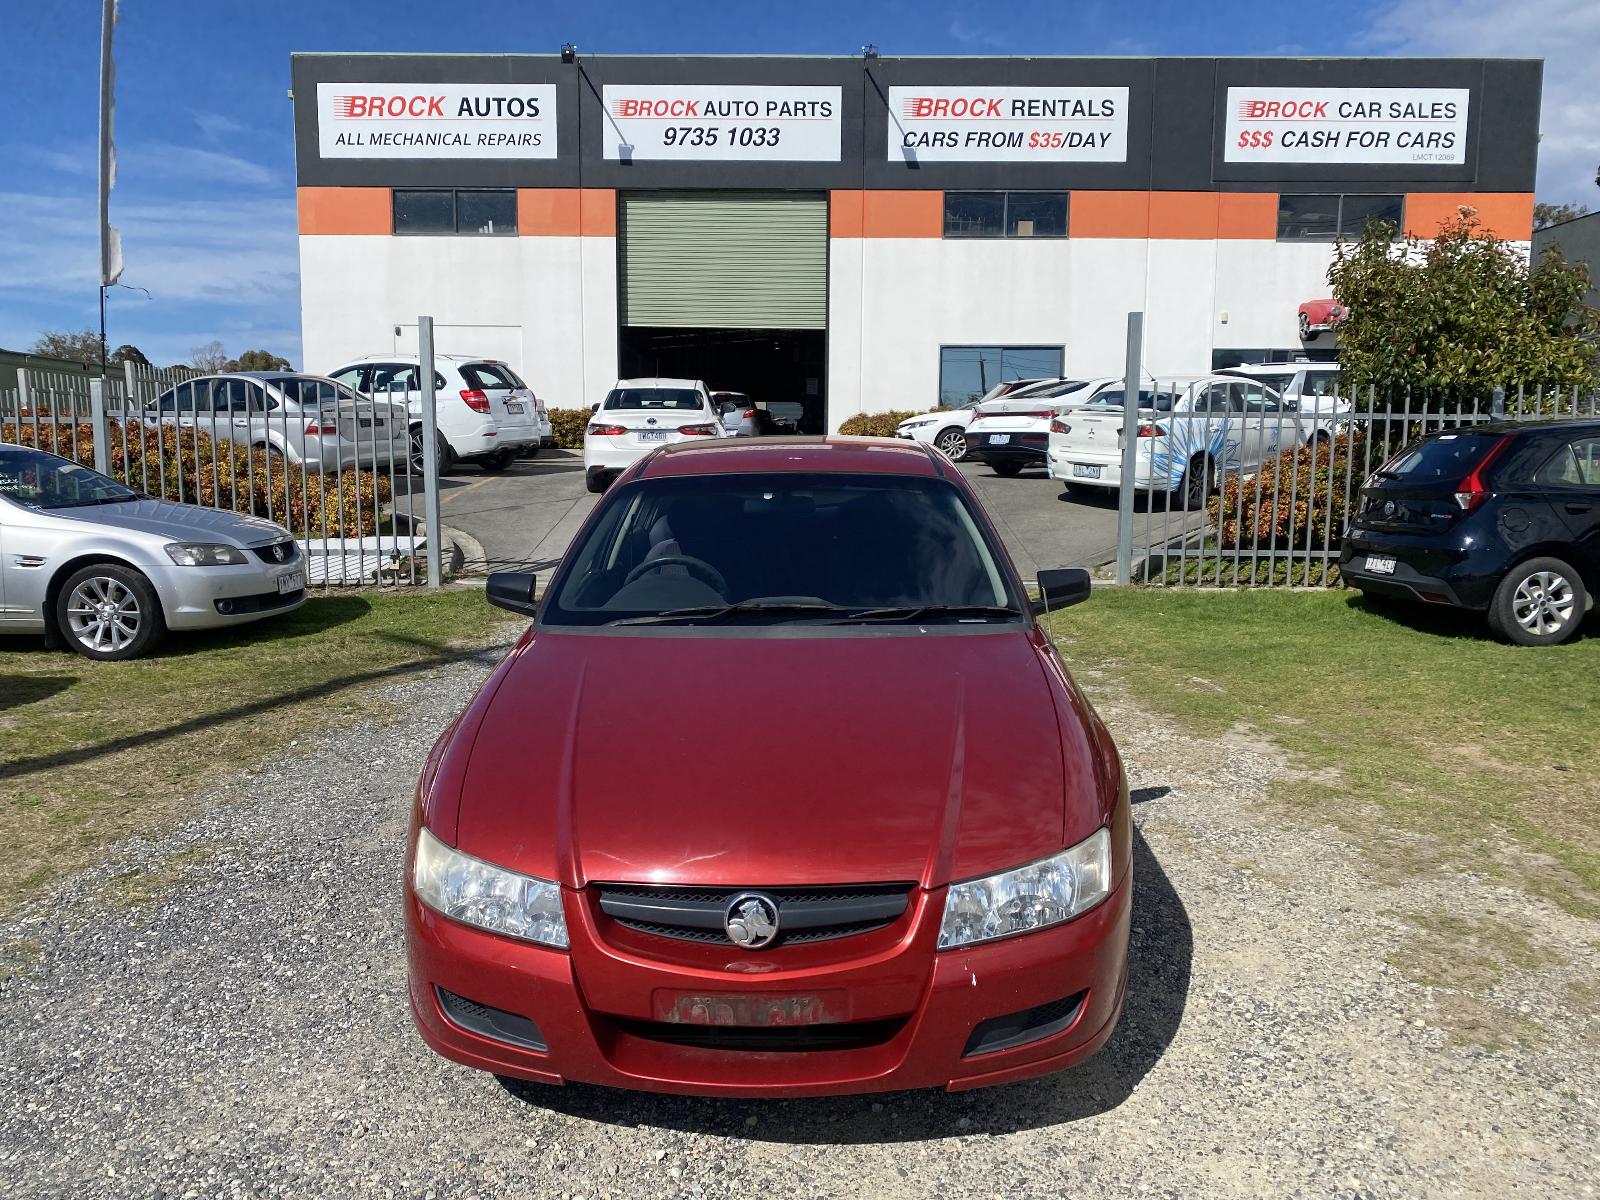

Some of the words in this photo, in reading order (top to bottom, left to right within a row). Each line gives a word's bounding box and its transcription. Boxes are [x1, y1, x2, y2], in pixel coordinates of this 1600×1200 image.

[343, 96, 446, 117] BROCK
[458, 97, 540, 118] AUTOS
[619, 100, 700, 117] BROCK
[704, 100, 759, 117] AUTO
[766, 100, 833, 118] PARTS
[906, 98, 1005, 117] BROCK
[1011, 99, 1115, 118] RENTALS
[1246, 101, 1330, 118] BROCK
[1339, 101, 1382, 118] CAR
[1389, 102, 1457, 119] SALES
[335, 132, 365, 146] ALL
[369, 132, 472, 146] MECHANICAL
[477, 133, 542, 147] REPAIRS
[663, 126, 720, 147] 9735
[727, 126, 781, 147] 1033
[903, 131, 960, 148] CARS
[965, 131, 1025, 148] FROM
[1028, 130, 1112, 150] $35/DAY
[1237, 129, 1274, 149] $$$
[1281, 130, 1340, 148] CASH
[1346, 131, 1391, 148] FOR
[1397, 131, 1456, 149] CARS
